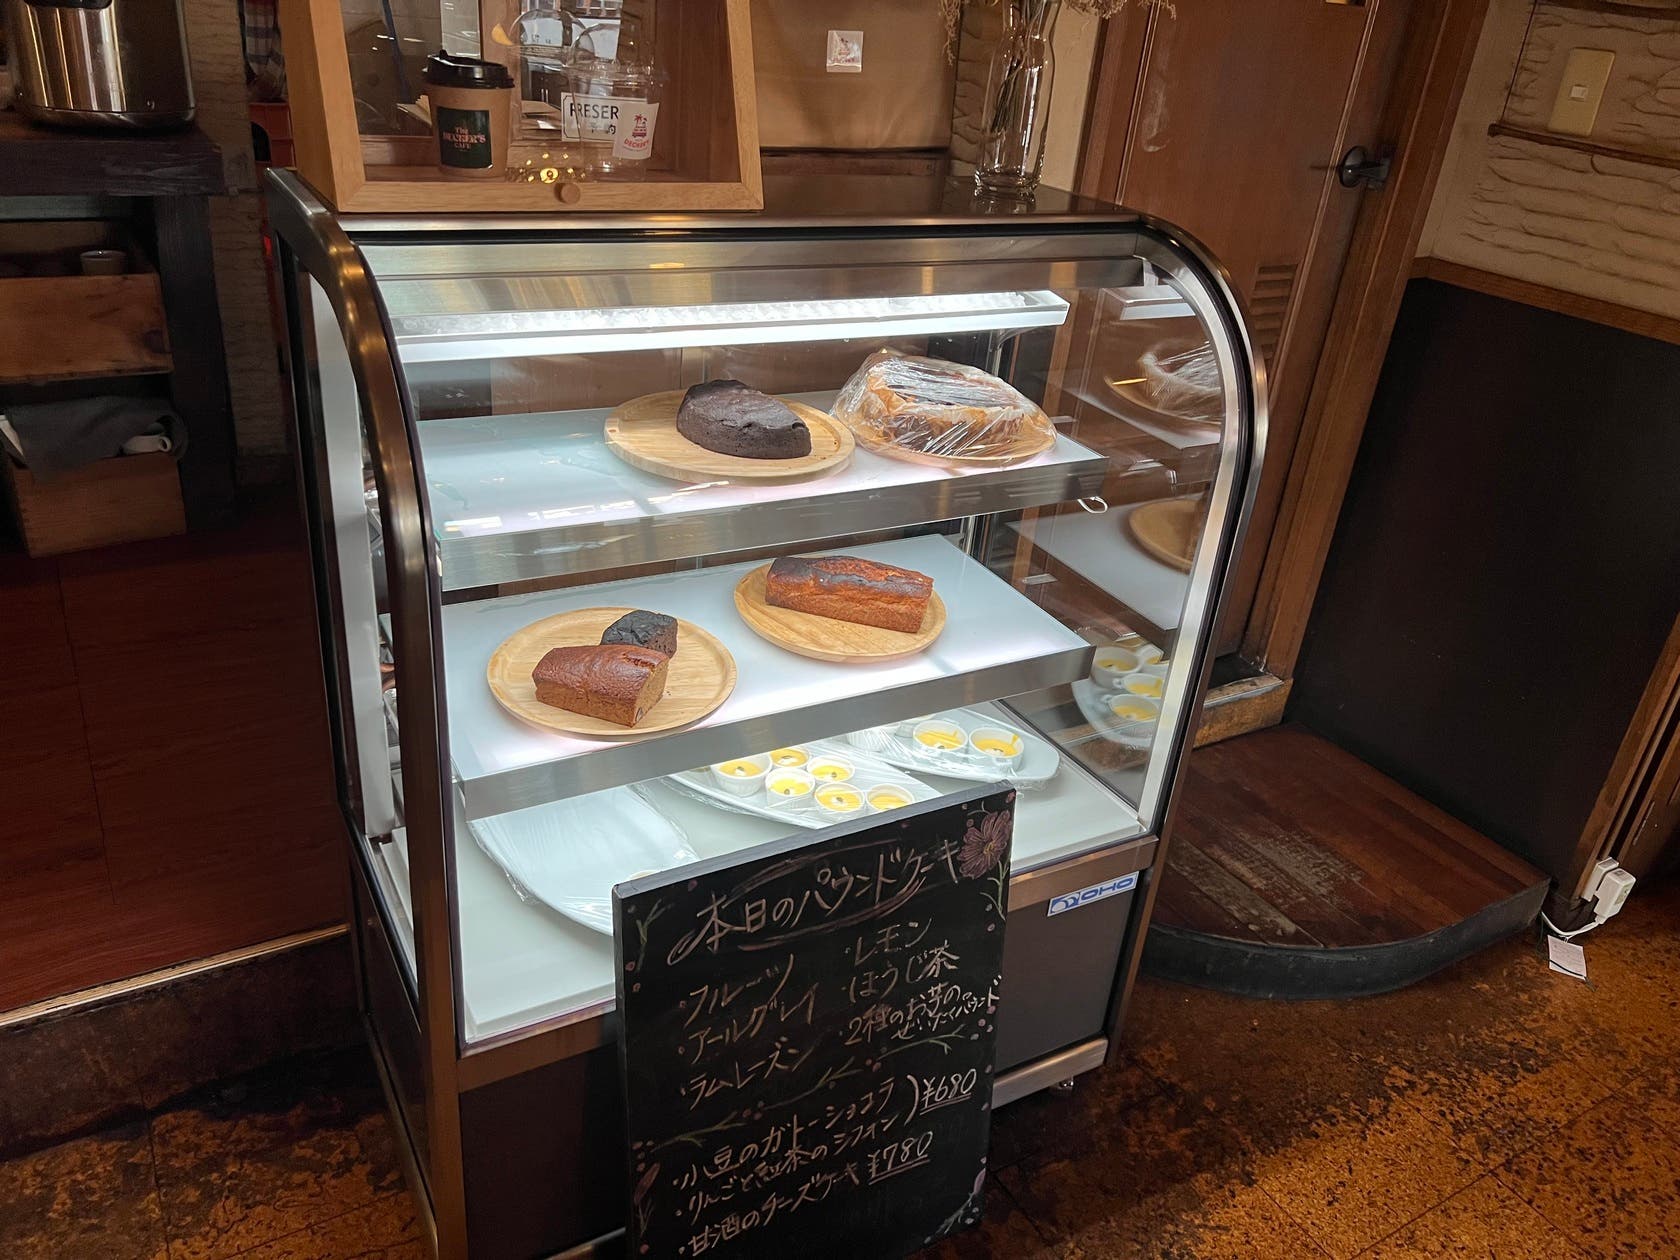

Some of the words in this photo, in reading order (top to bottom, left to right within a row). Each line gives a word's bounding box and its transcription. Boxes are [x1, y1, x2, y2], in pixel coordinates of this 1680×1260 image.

[668, 839, 959, 964] 本日のパウンドケーキ
[855, 918, 932, 965] レモン
[684, 953, 794, 1029] フルーツ
[851, 939, 960, 1003] ほうじ茶
[688, 983, 820, 1064] アールグレイ
[690, 1032, 828, 1110] ラムレーズン
[680, 1076, 894, 1190] 小豆のガトーショコラ
[689, 1113, 899, 1226] りんごと紅茶のシフォン
[688, 1161, 859, 1256] 甘酒のチーズケーキ
